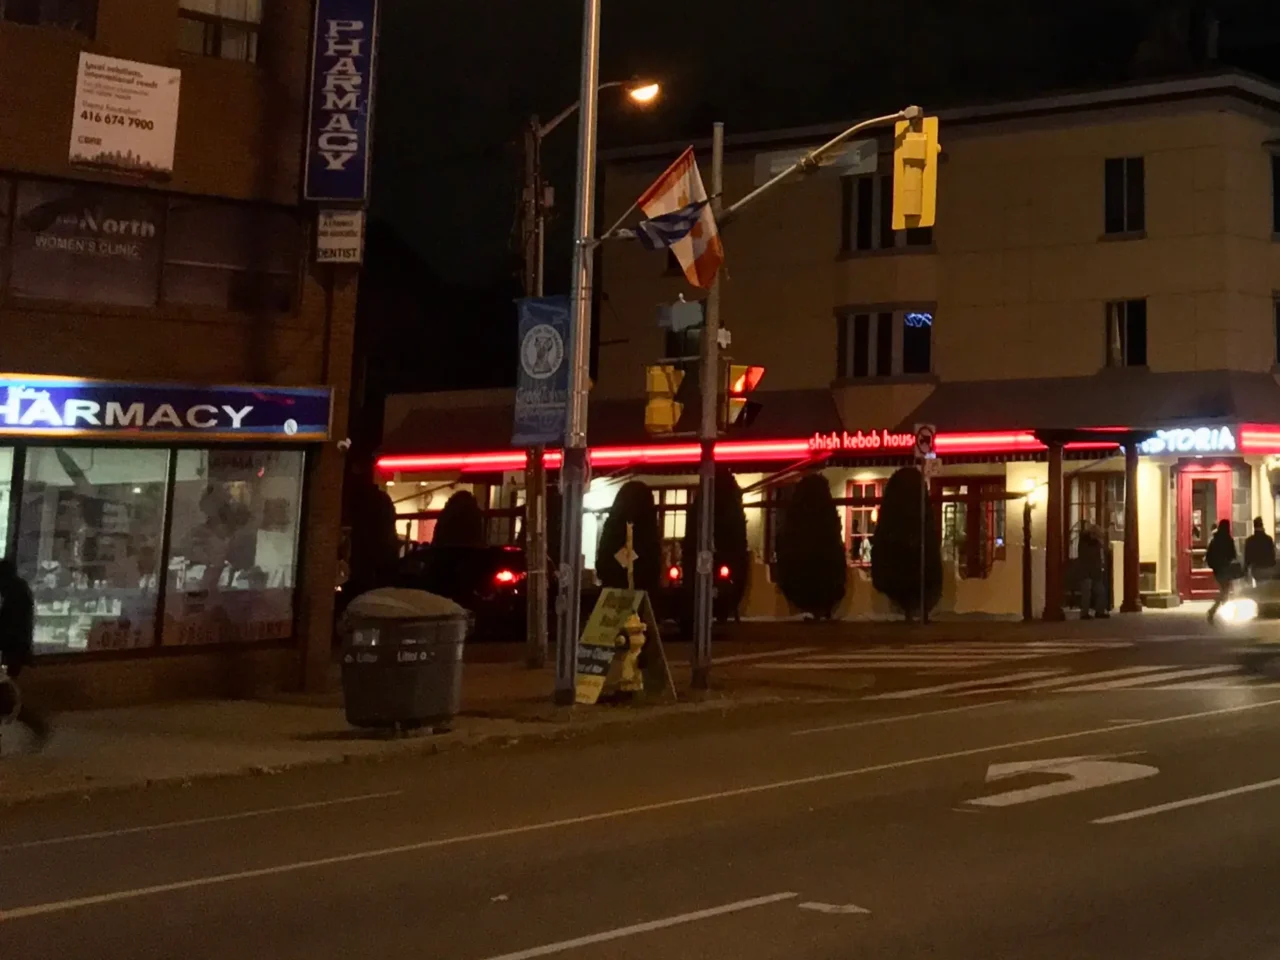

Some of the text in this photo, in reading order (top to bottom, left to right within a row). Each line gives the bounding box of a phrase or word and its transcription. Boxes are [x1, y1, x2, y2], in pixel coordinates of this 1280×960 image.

[318, 19, 364, 170] PHARMACY
[80, 110, 154, 131] 416 674 7900
[0, 398, 254, 429] HARMACY
[809, 431, 840, 450] shish
[843, 430, 880, 449] kebob
